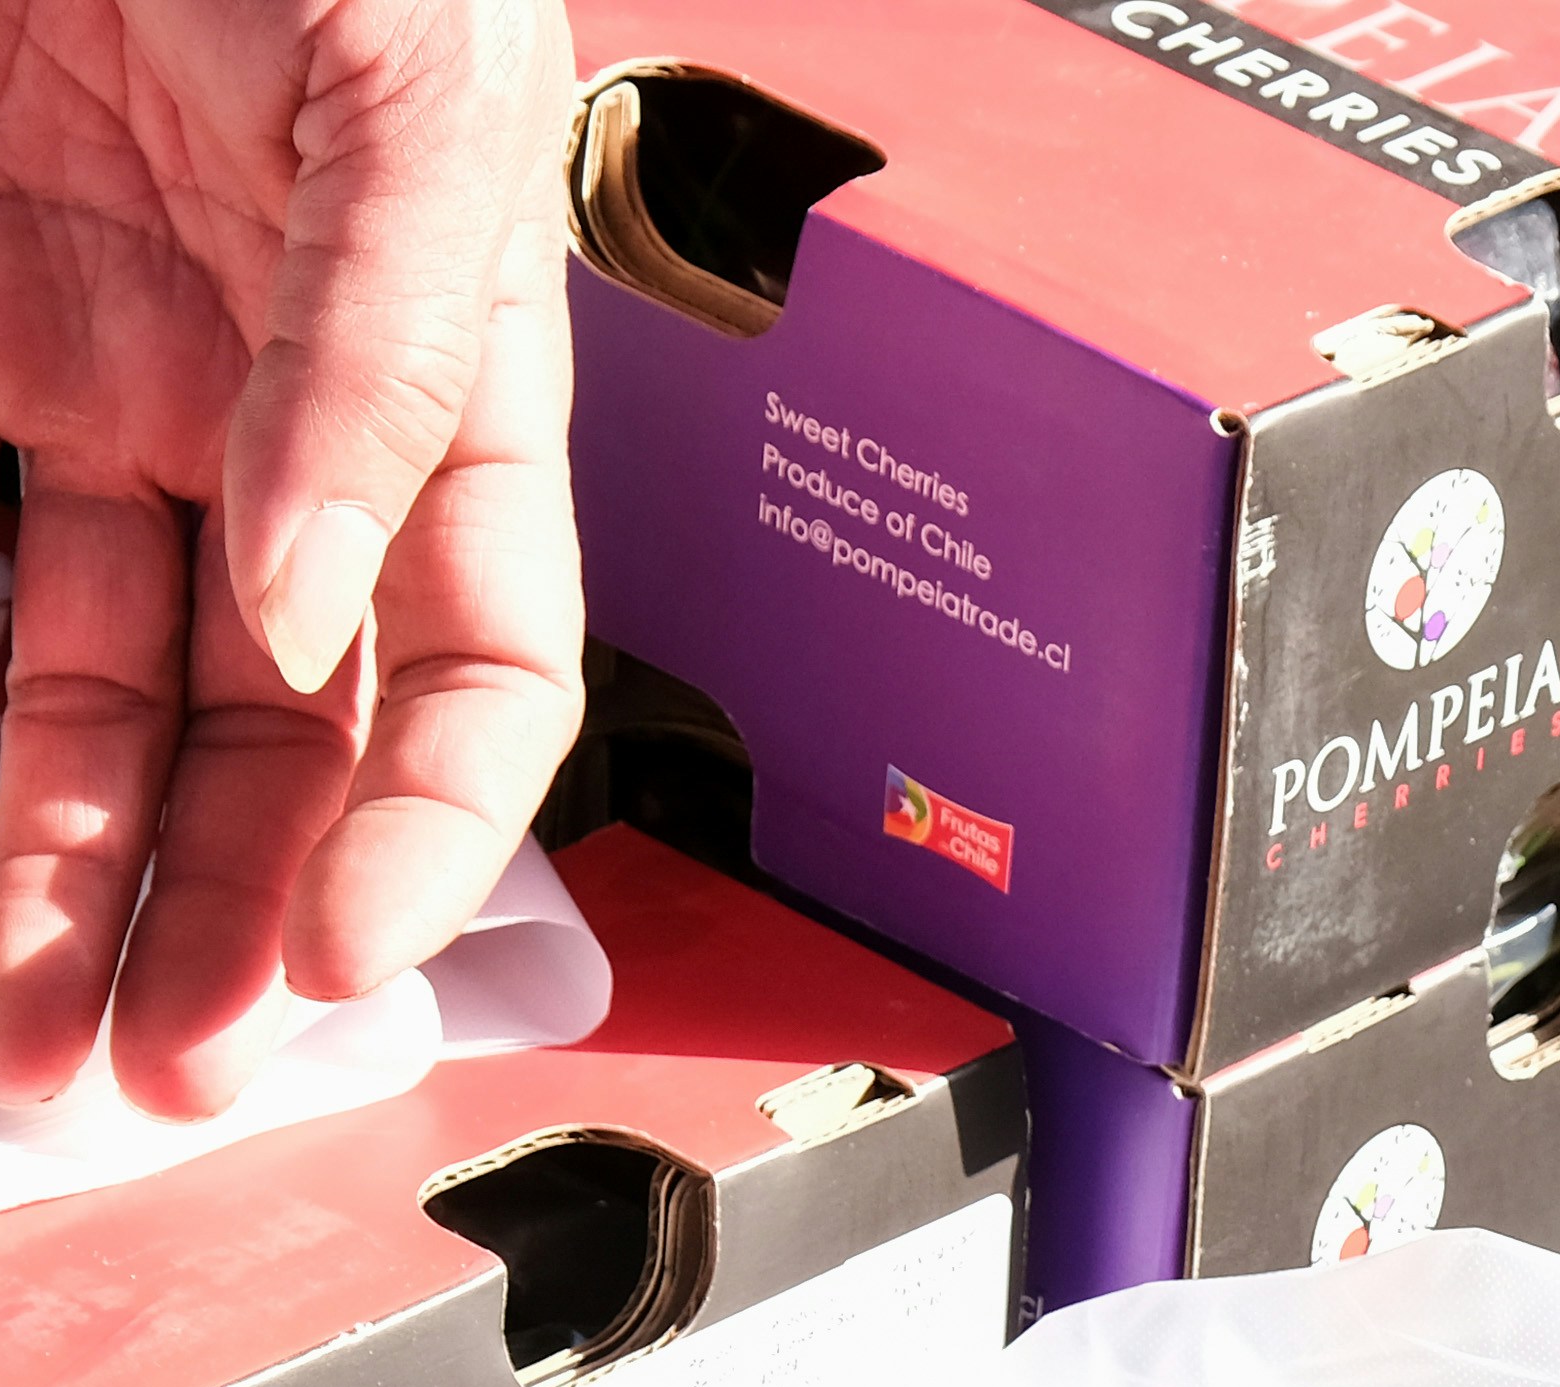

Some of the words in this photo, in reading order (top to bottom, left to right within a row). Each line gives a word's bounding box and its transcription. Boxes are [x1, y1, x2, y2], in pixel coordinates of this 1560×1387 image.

[1110, 0, 1503, 187] CHERRIES
[762, 442, 880, 525] Produce
[885, 510, 917, 542] of
[920, 523, 992, 580] Chile
[765, 391, 851, 459] Sweet
[856, 438, 969, 517] Cherries
[758, 493, 1071, 674] info@pompeiatrade.cl
[940, 806, 1002, 854] Frutas
[949, 835, 999, 877] Chile
